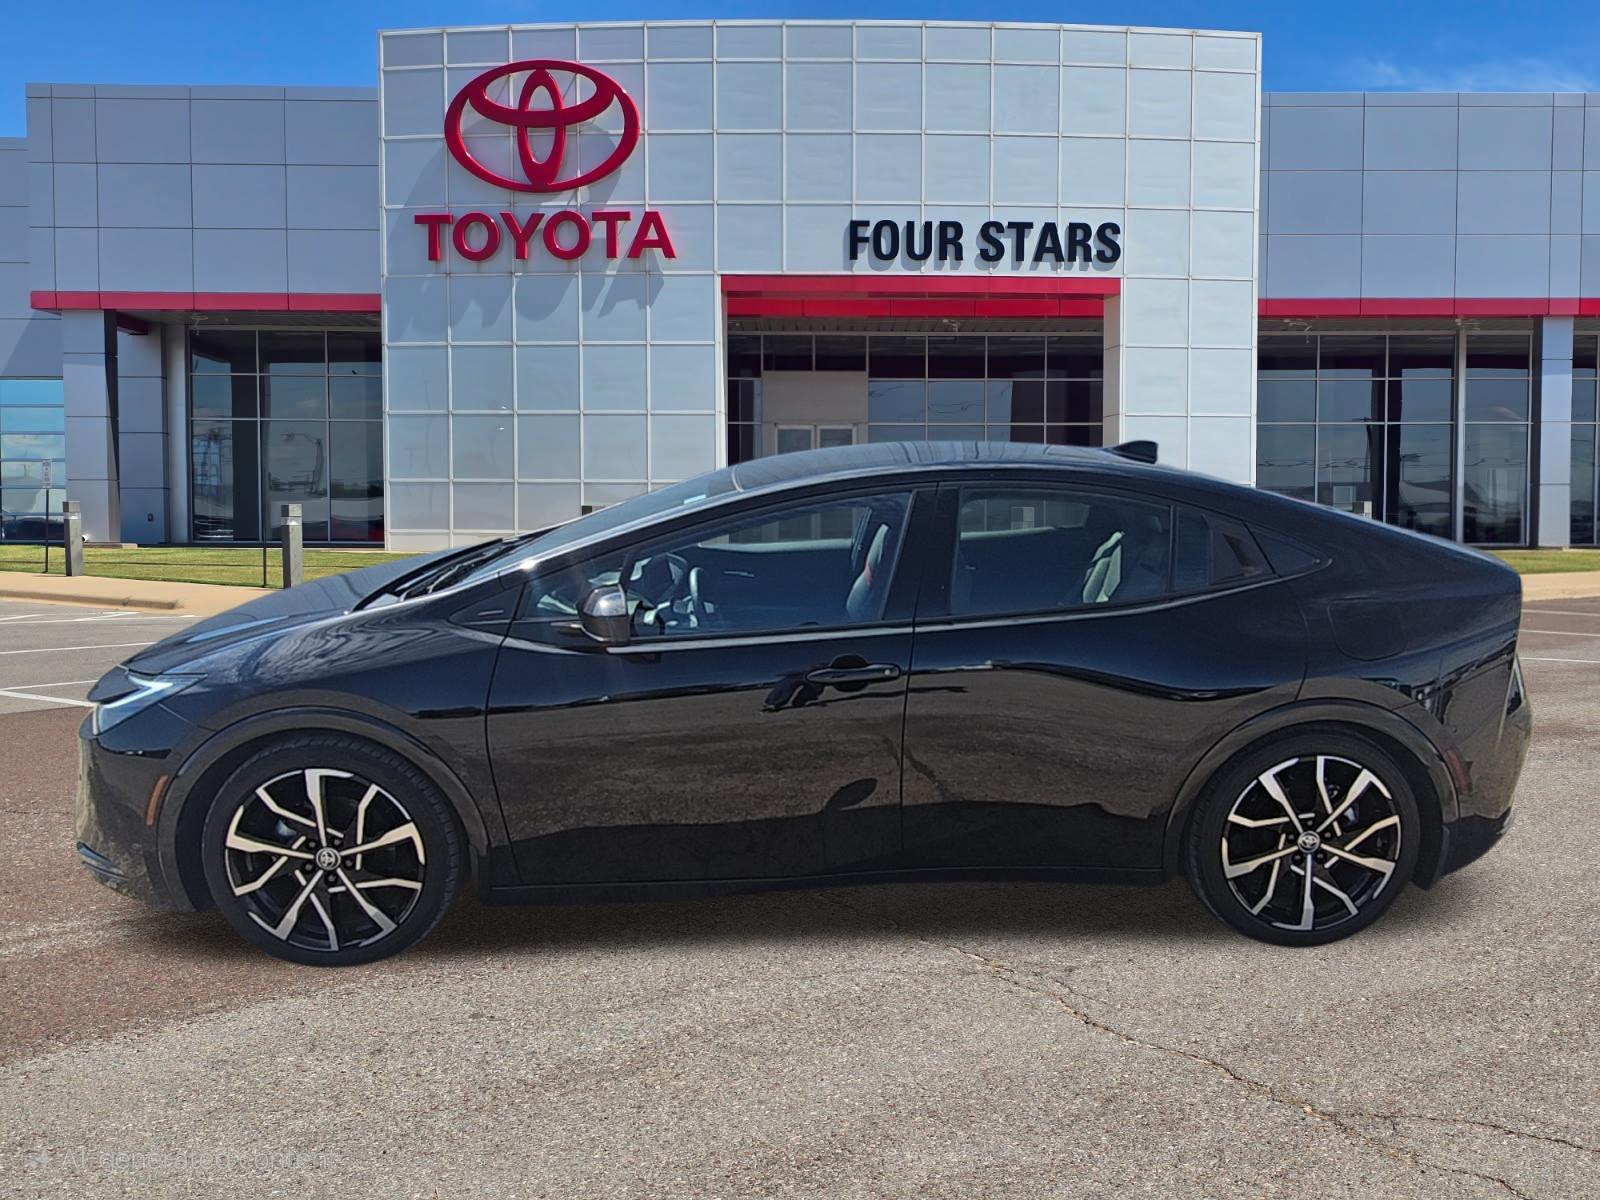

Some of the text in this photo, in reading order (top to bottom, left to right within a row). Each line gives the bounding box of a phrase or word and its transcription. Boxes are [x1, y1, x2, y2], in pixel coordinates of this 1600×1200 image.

[414, 211, 677, 261] TOYOTA
[849, 219, 1121, 264] FOUR STARS
